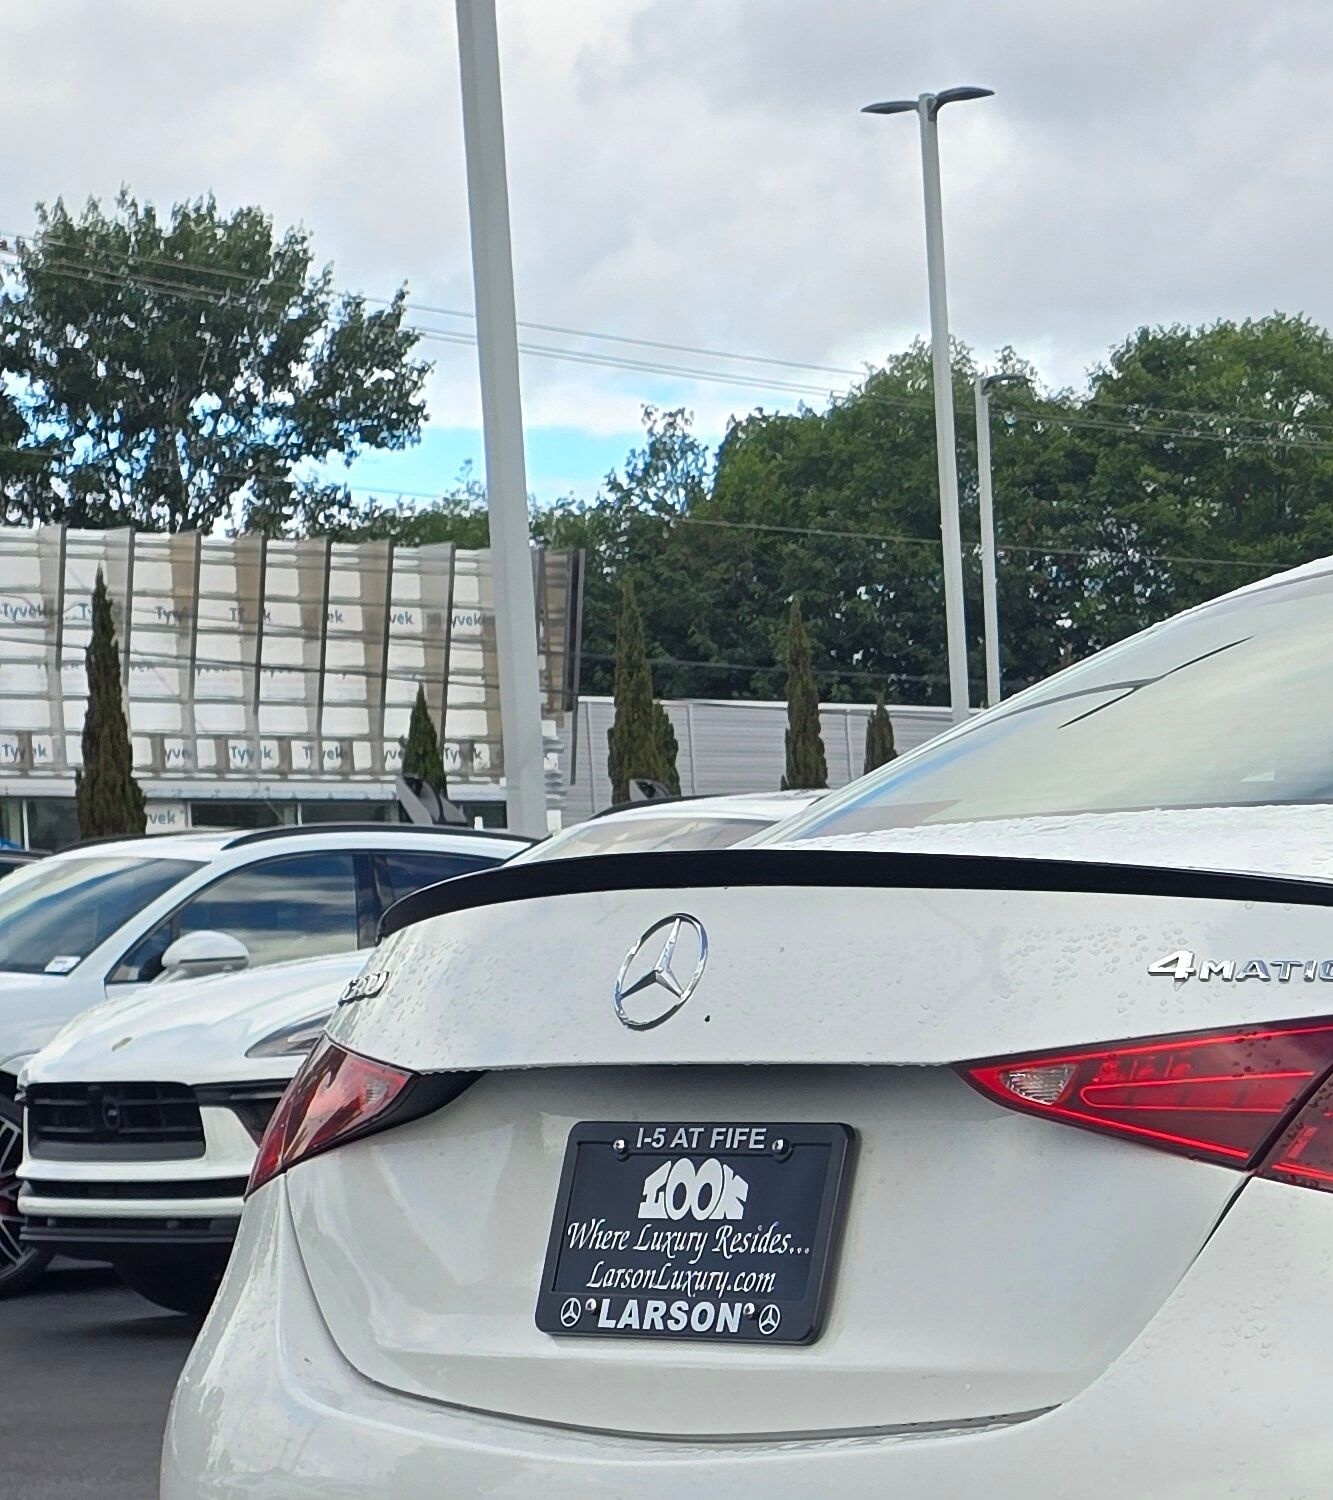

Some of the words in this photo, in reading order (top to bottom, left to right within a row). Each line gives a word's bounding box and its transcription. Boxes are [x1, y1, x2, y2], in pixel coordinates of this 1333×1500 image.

[636, 1127, 667, 1149] I-5
[670, 1127, 704, 1149] AT
[709, 1127, 767, 1149] FIFE
[567, 1218, 630, 1251] Where
[632, 1223, 708, 1264] Luxury
[712, 1220, 810, 1259] Resides...
[585, 1260, 776, 1298] LarsonLuxury.com
[597, 1298, 743, 1333] LARSON
